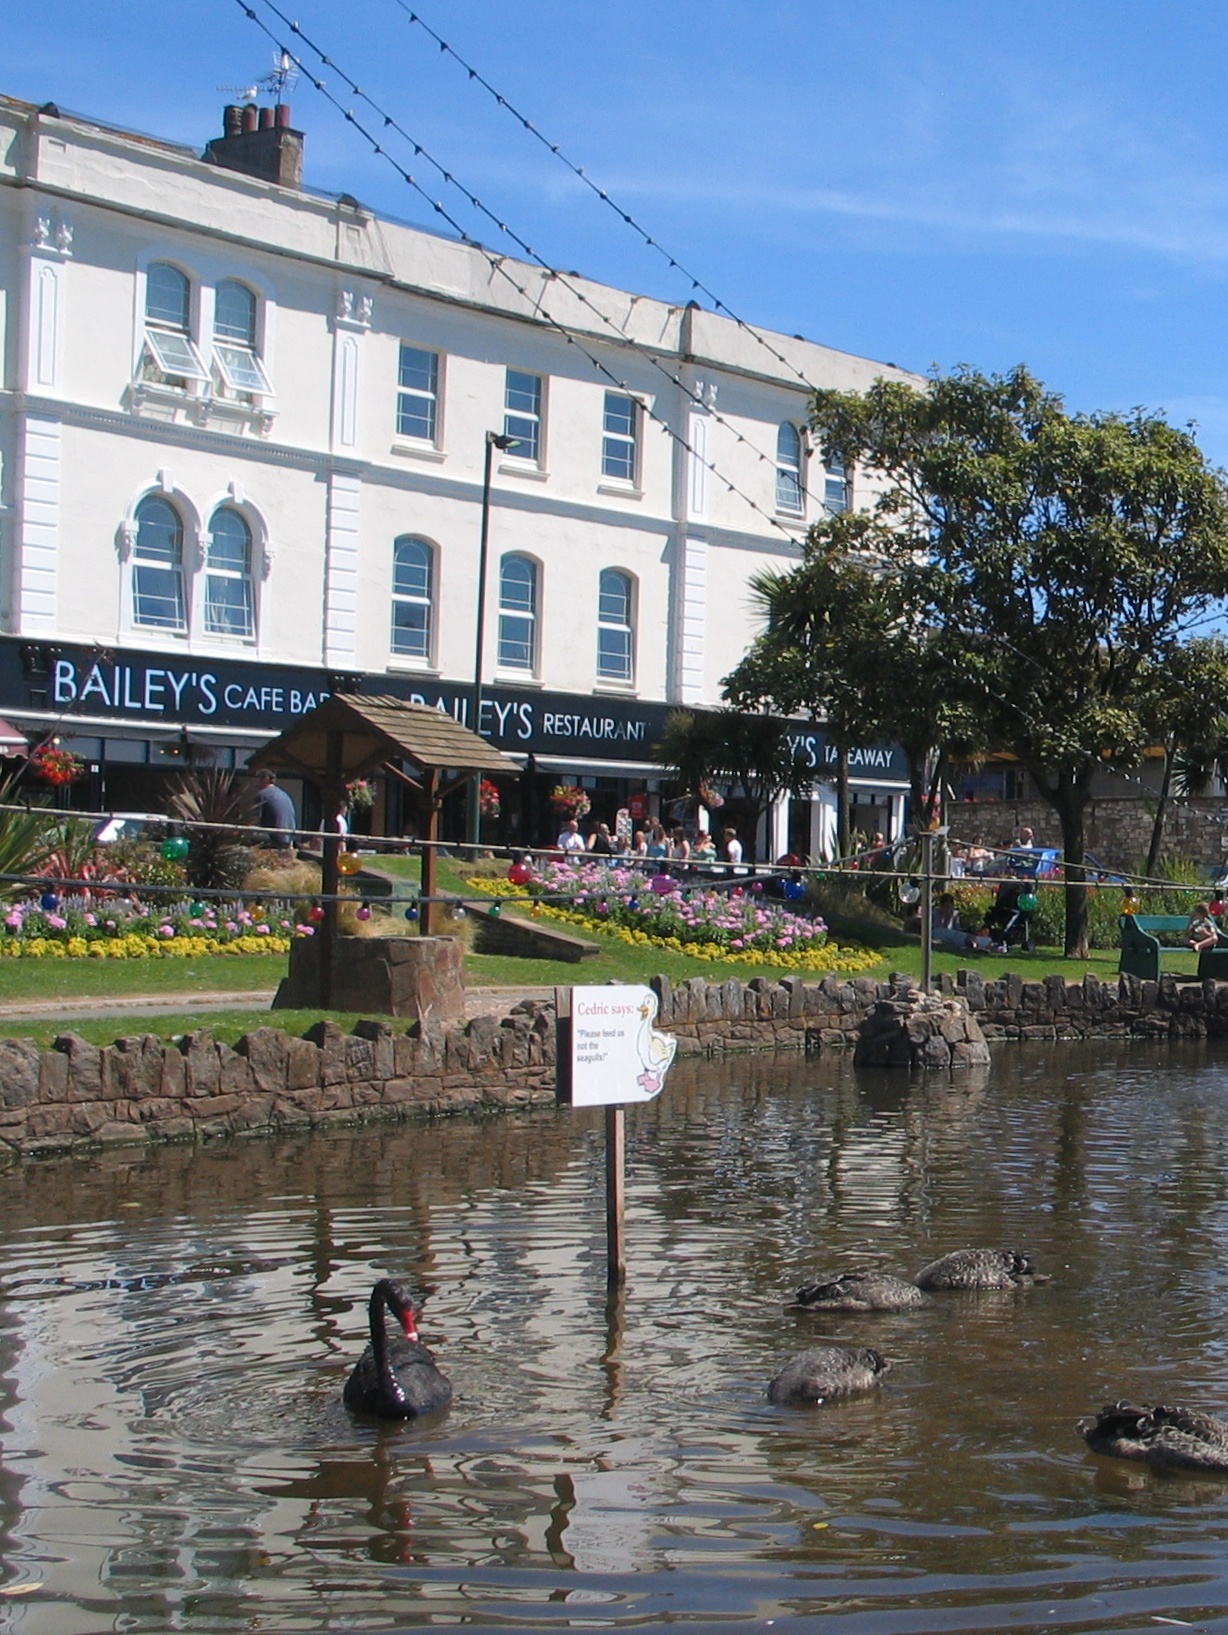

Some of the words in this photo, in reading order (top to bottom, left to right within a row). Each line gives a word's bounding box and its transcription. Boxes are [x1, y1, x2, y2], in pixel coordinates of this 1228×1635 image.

[54, 659, 218, 715] BAILEY'S
[223, 684, 285, 712] CAFE
[543, 712, 648, 741] RESTAURANT
[823, 745, 893, 768] TAEAWAY
[577, 1002, 609, 1016] Cedric
[611, 1005, 635, 1018] says:
[589, 1041, 599, 1050] the
